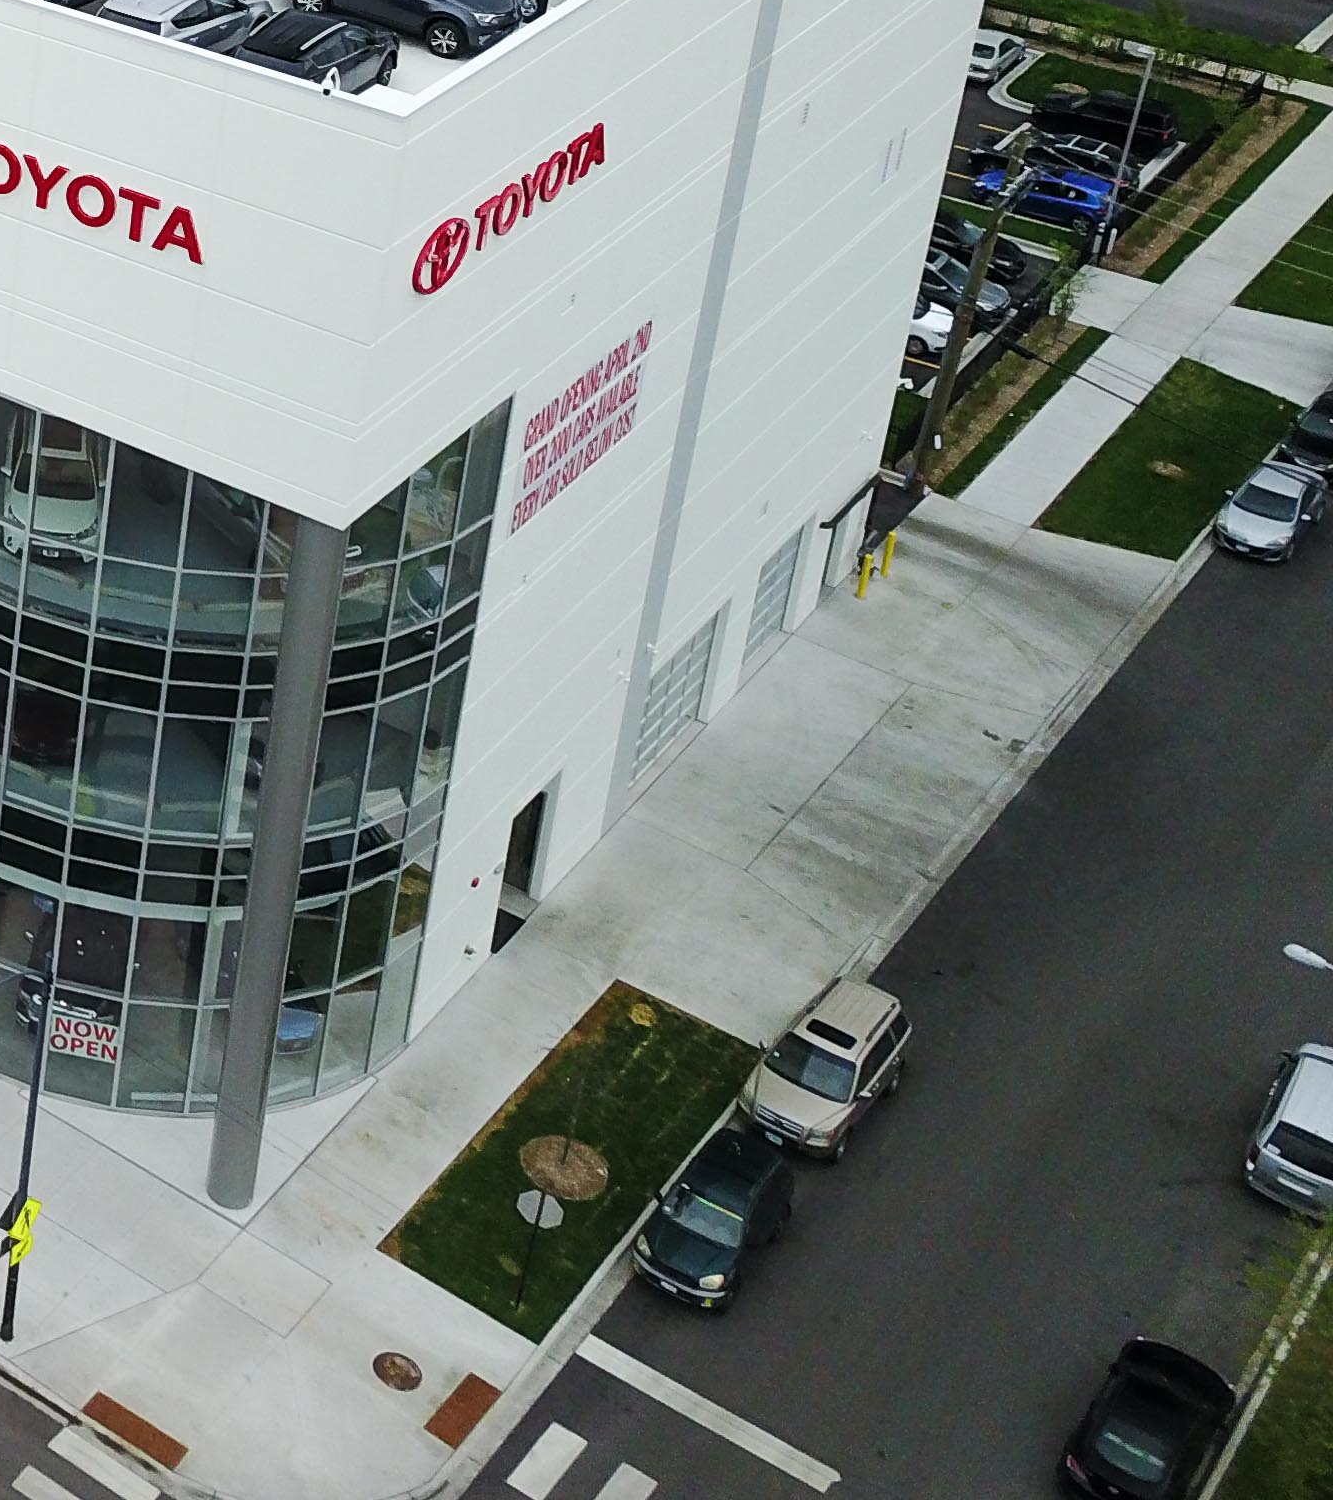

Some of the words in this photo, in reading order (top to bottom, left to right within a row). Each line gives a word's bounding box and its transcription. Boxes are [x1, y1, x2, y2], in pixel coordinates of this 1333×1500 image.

[475, 122, 605, 252] TOYOTA
[523, 443, 548, 490] OVER
[548, 422, 572, 469] 2000
[573, 401, 596, 448] CARS
[597, 364, 641, 425] AVAILABLE
[524, 397, 559, 452] GRAND
[560, 360, 603, 422] OPENING
[605, 338, 631, 382] APRIL
[631, 320, 653, 363] 2ND
[511, 486, 541, 536] EVERY
[541, 469, 560, 508] CAR
[560, 448, 583, 492] SOLD
[583, 426, 613, 471] BELOW
[614, 402, 637, 446] COST
[49, 1034, 118, 1061] OPEN
[55, 1017, 117, 1043] NOW
